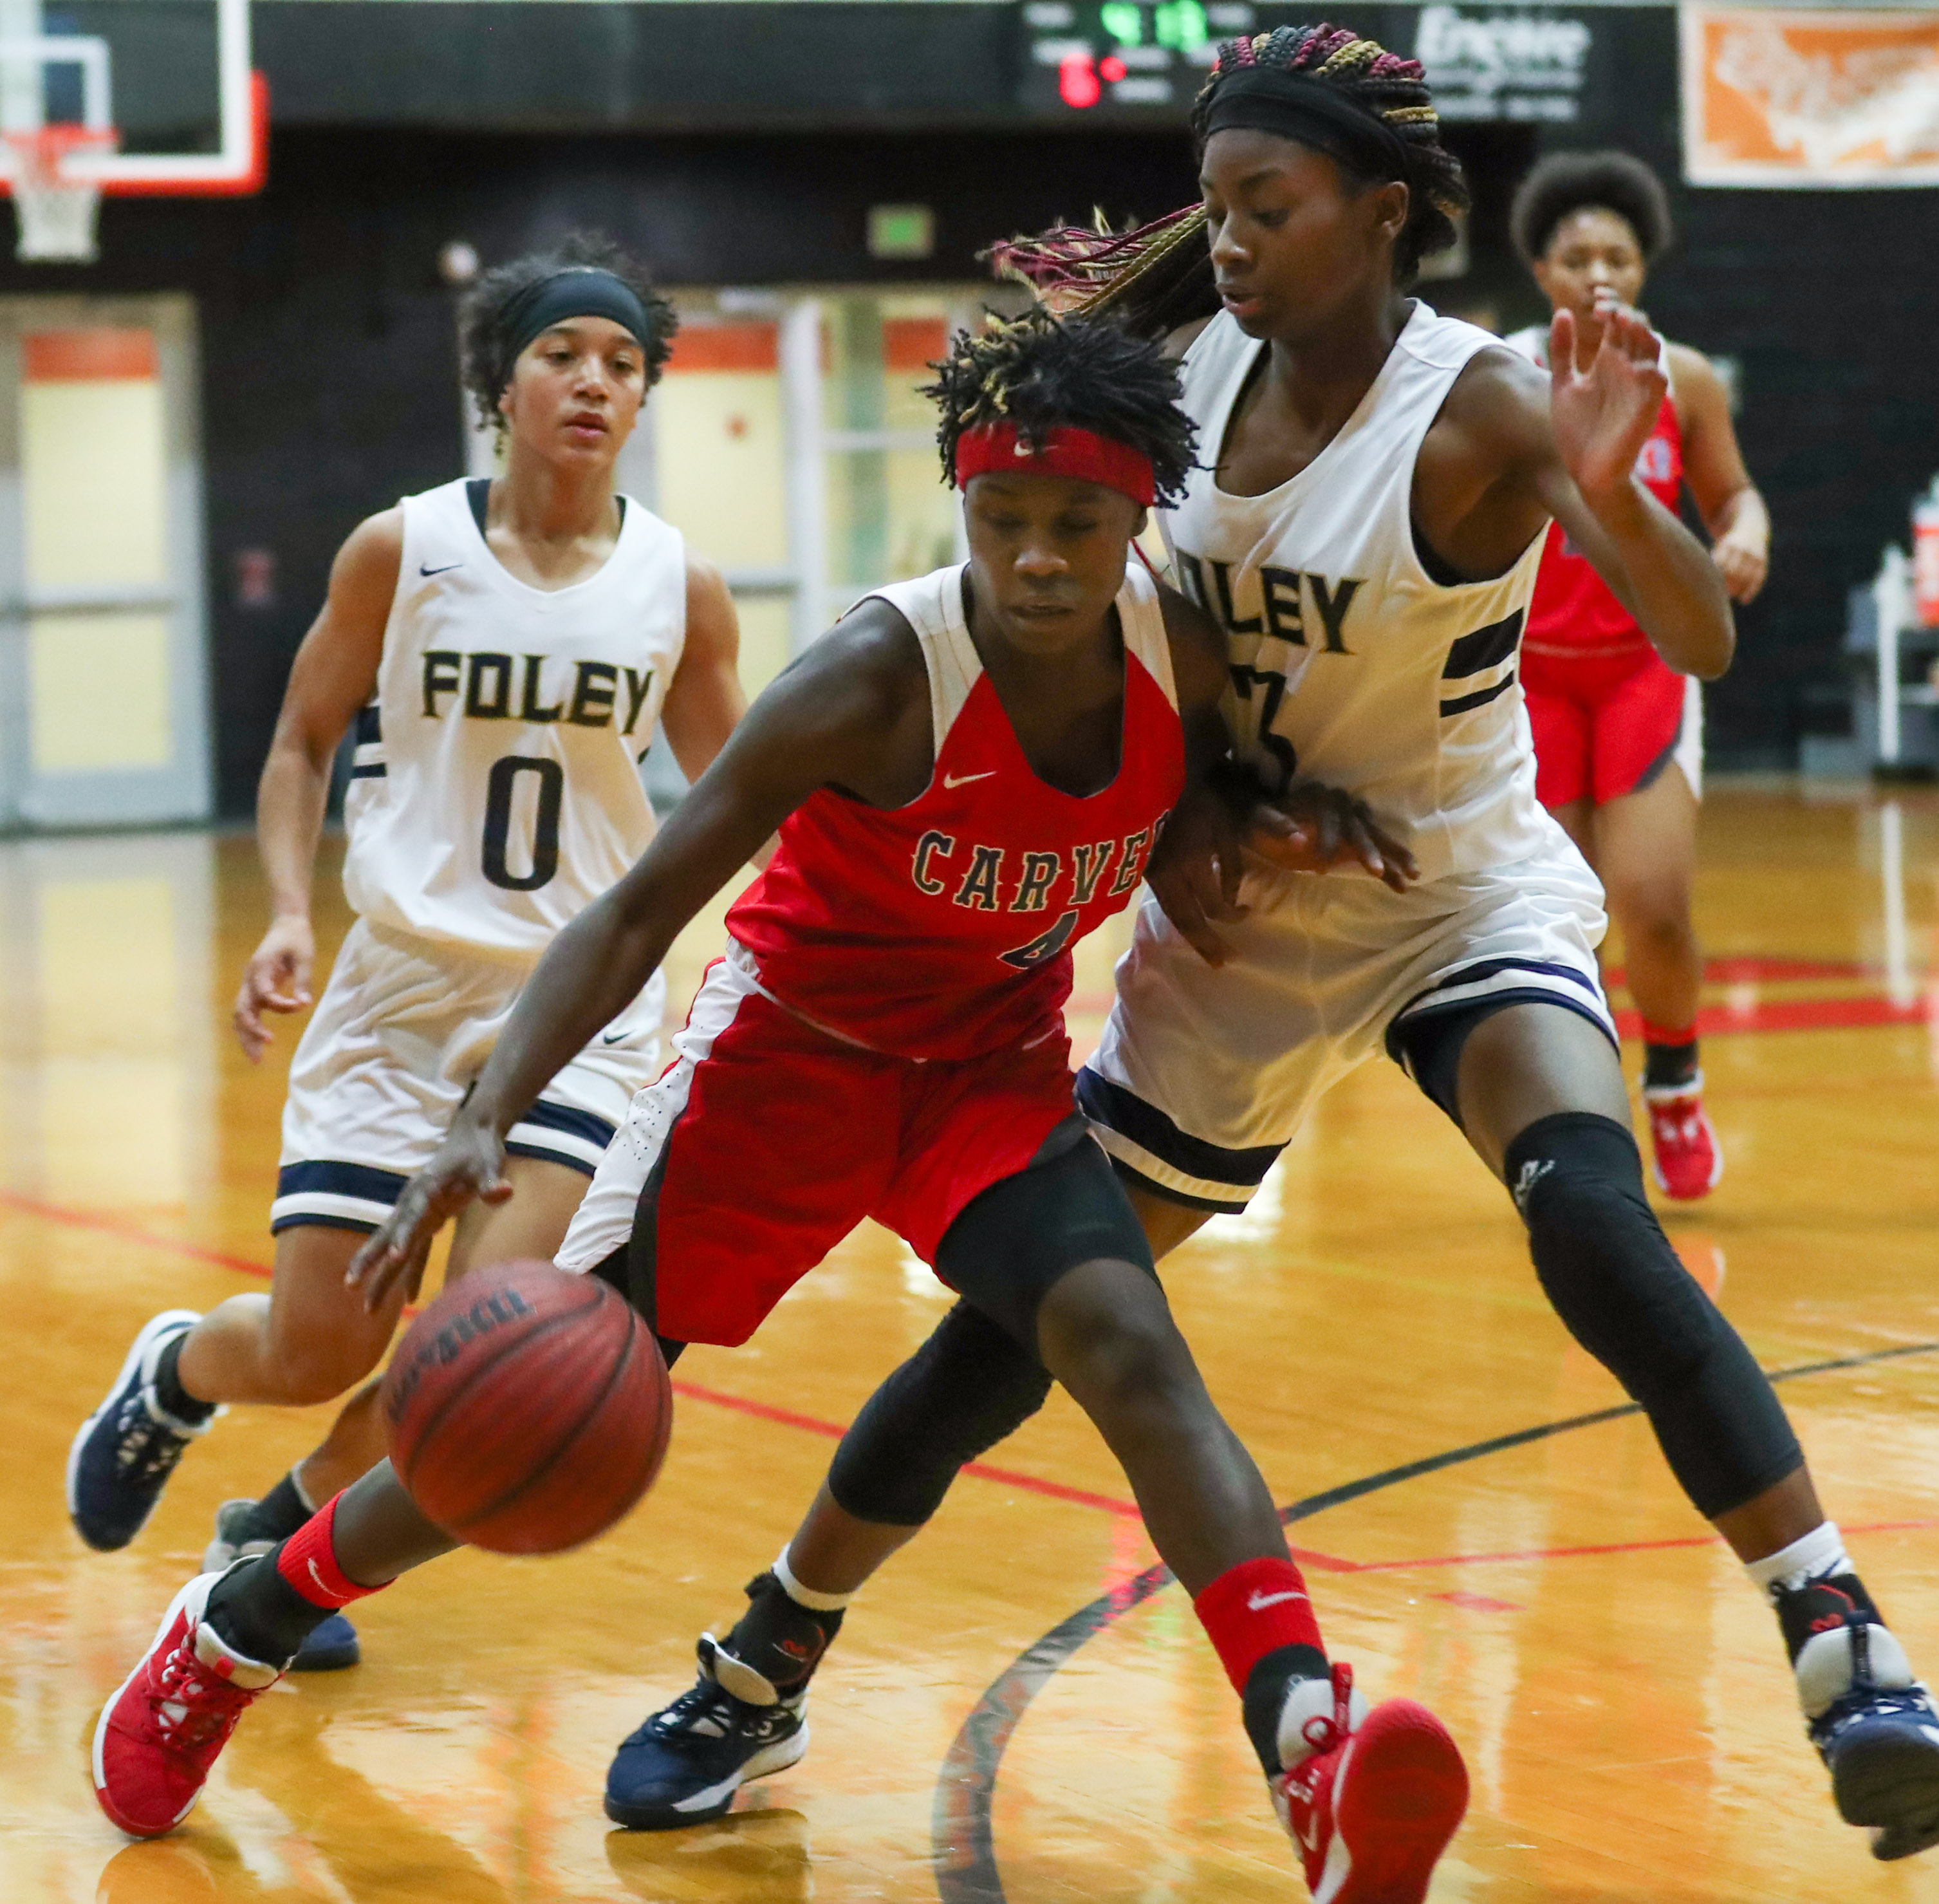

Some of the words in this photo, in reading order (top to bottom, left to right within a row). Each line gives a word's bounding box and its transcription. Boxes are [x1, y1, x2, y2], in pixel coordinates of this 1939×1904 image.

[1176, 547, 1369, 656] OLEY
[422, 650, 655, 735] FOLEY
[481, 755, 564, 892] 0
